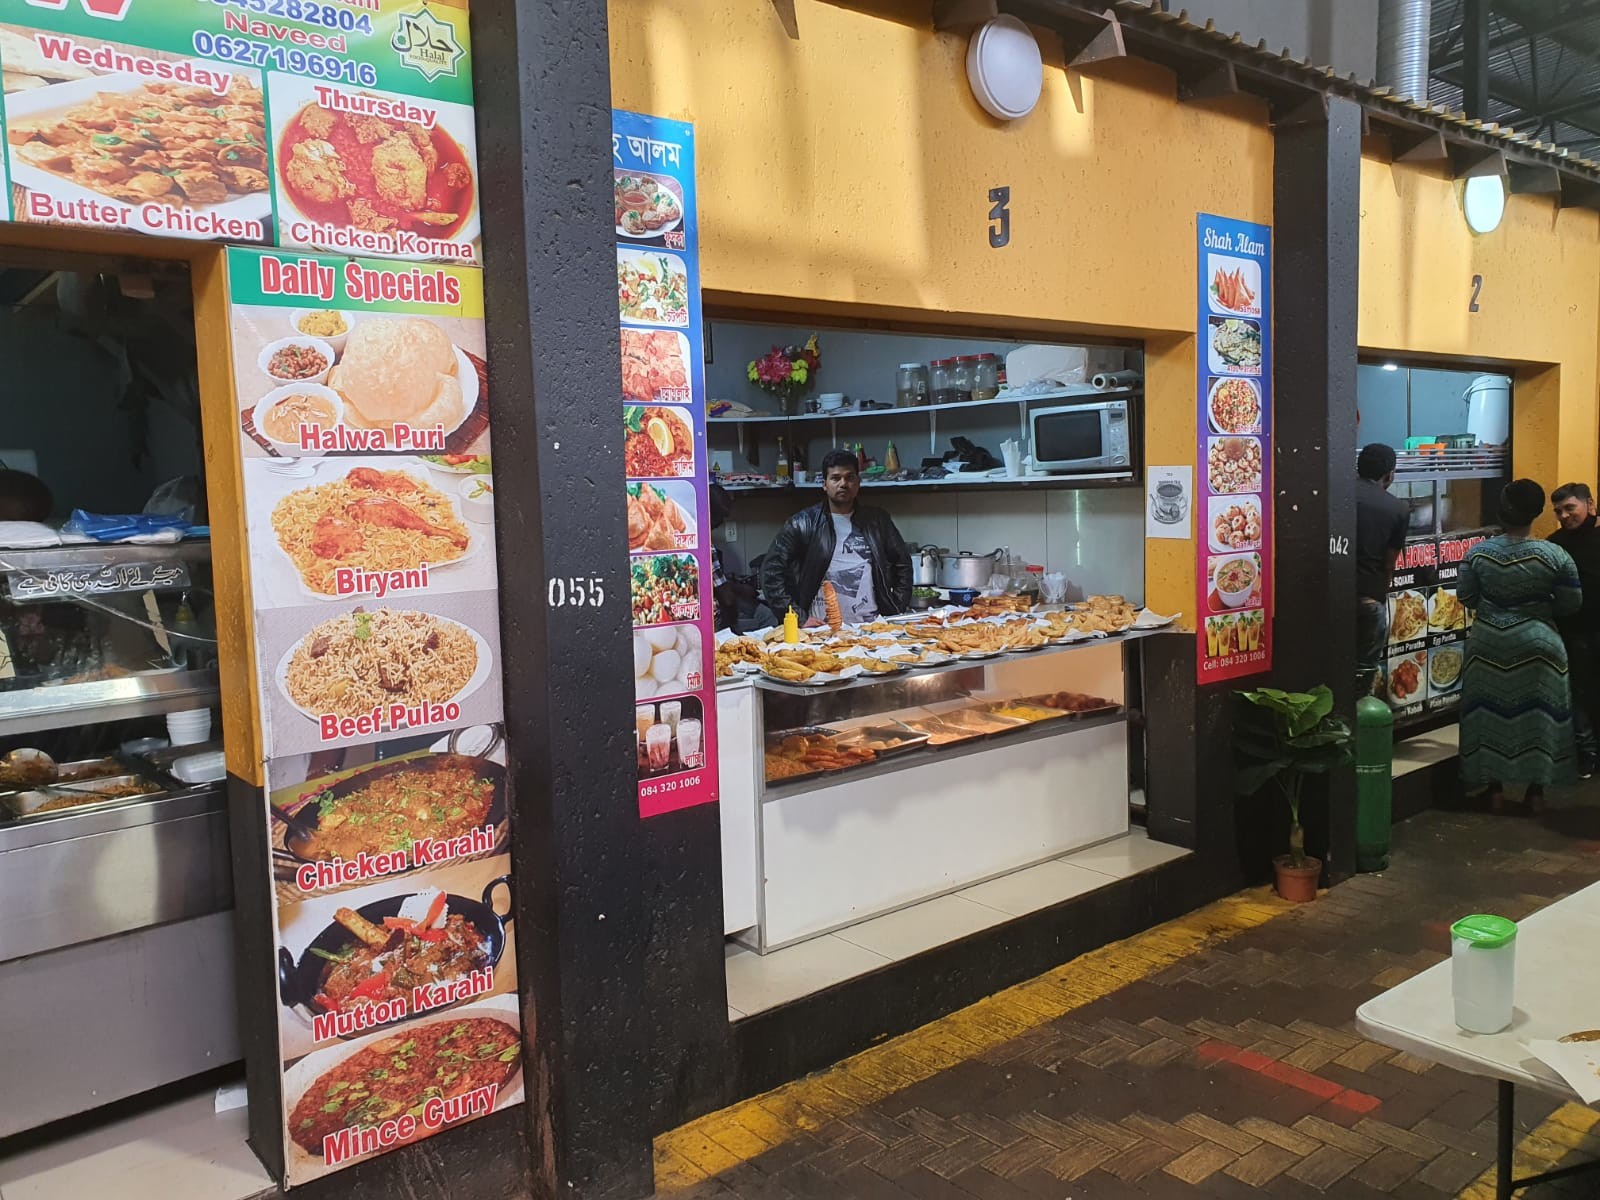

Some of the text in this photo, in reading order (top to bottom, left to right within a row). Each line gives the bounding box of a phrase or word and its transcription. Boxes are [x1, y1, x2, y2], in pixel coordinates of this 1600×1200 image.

[224, 11, 347, 53] Naveed
[36, 34, 231, 95] Wednesday
[193, 31, 376, 86] 0627196916
[420, 48, 445, 61] Halal
[313, 85, 437, 128] Thursday
[626, 136, 682, 169] আলম
[28, 190, 264, 240] Butter Chicken
[988, 186, 1010, 249] 3
[290, 221, 474, 259] Chicken Korma
[1203, 227, 1265, 257] Shah Alam
[259, 255, 461, 305] Daily Specials
[1468, 274, 1483, 313] 2
[299, 422, 445, 451] Halwa Puri
[1329, 535, 1349, 555] 042
[1405, 542, 1438, 571] HOUSE,
[336, 563, 429, 599] Biryani
[548, 577, 604, 607] 055
[1203, 650, 1266, 671] Cell: 084 320 1006
[319, 700, 461, 741] Beef Pulao
[641, 776, 701, 797] 084 320 1006
[296, 824, 496, 892] Chicken Karahi
[312, 966, 494, 1042] Mutton Karahi
[323, 1082, 498, 1167] Mince Curry
